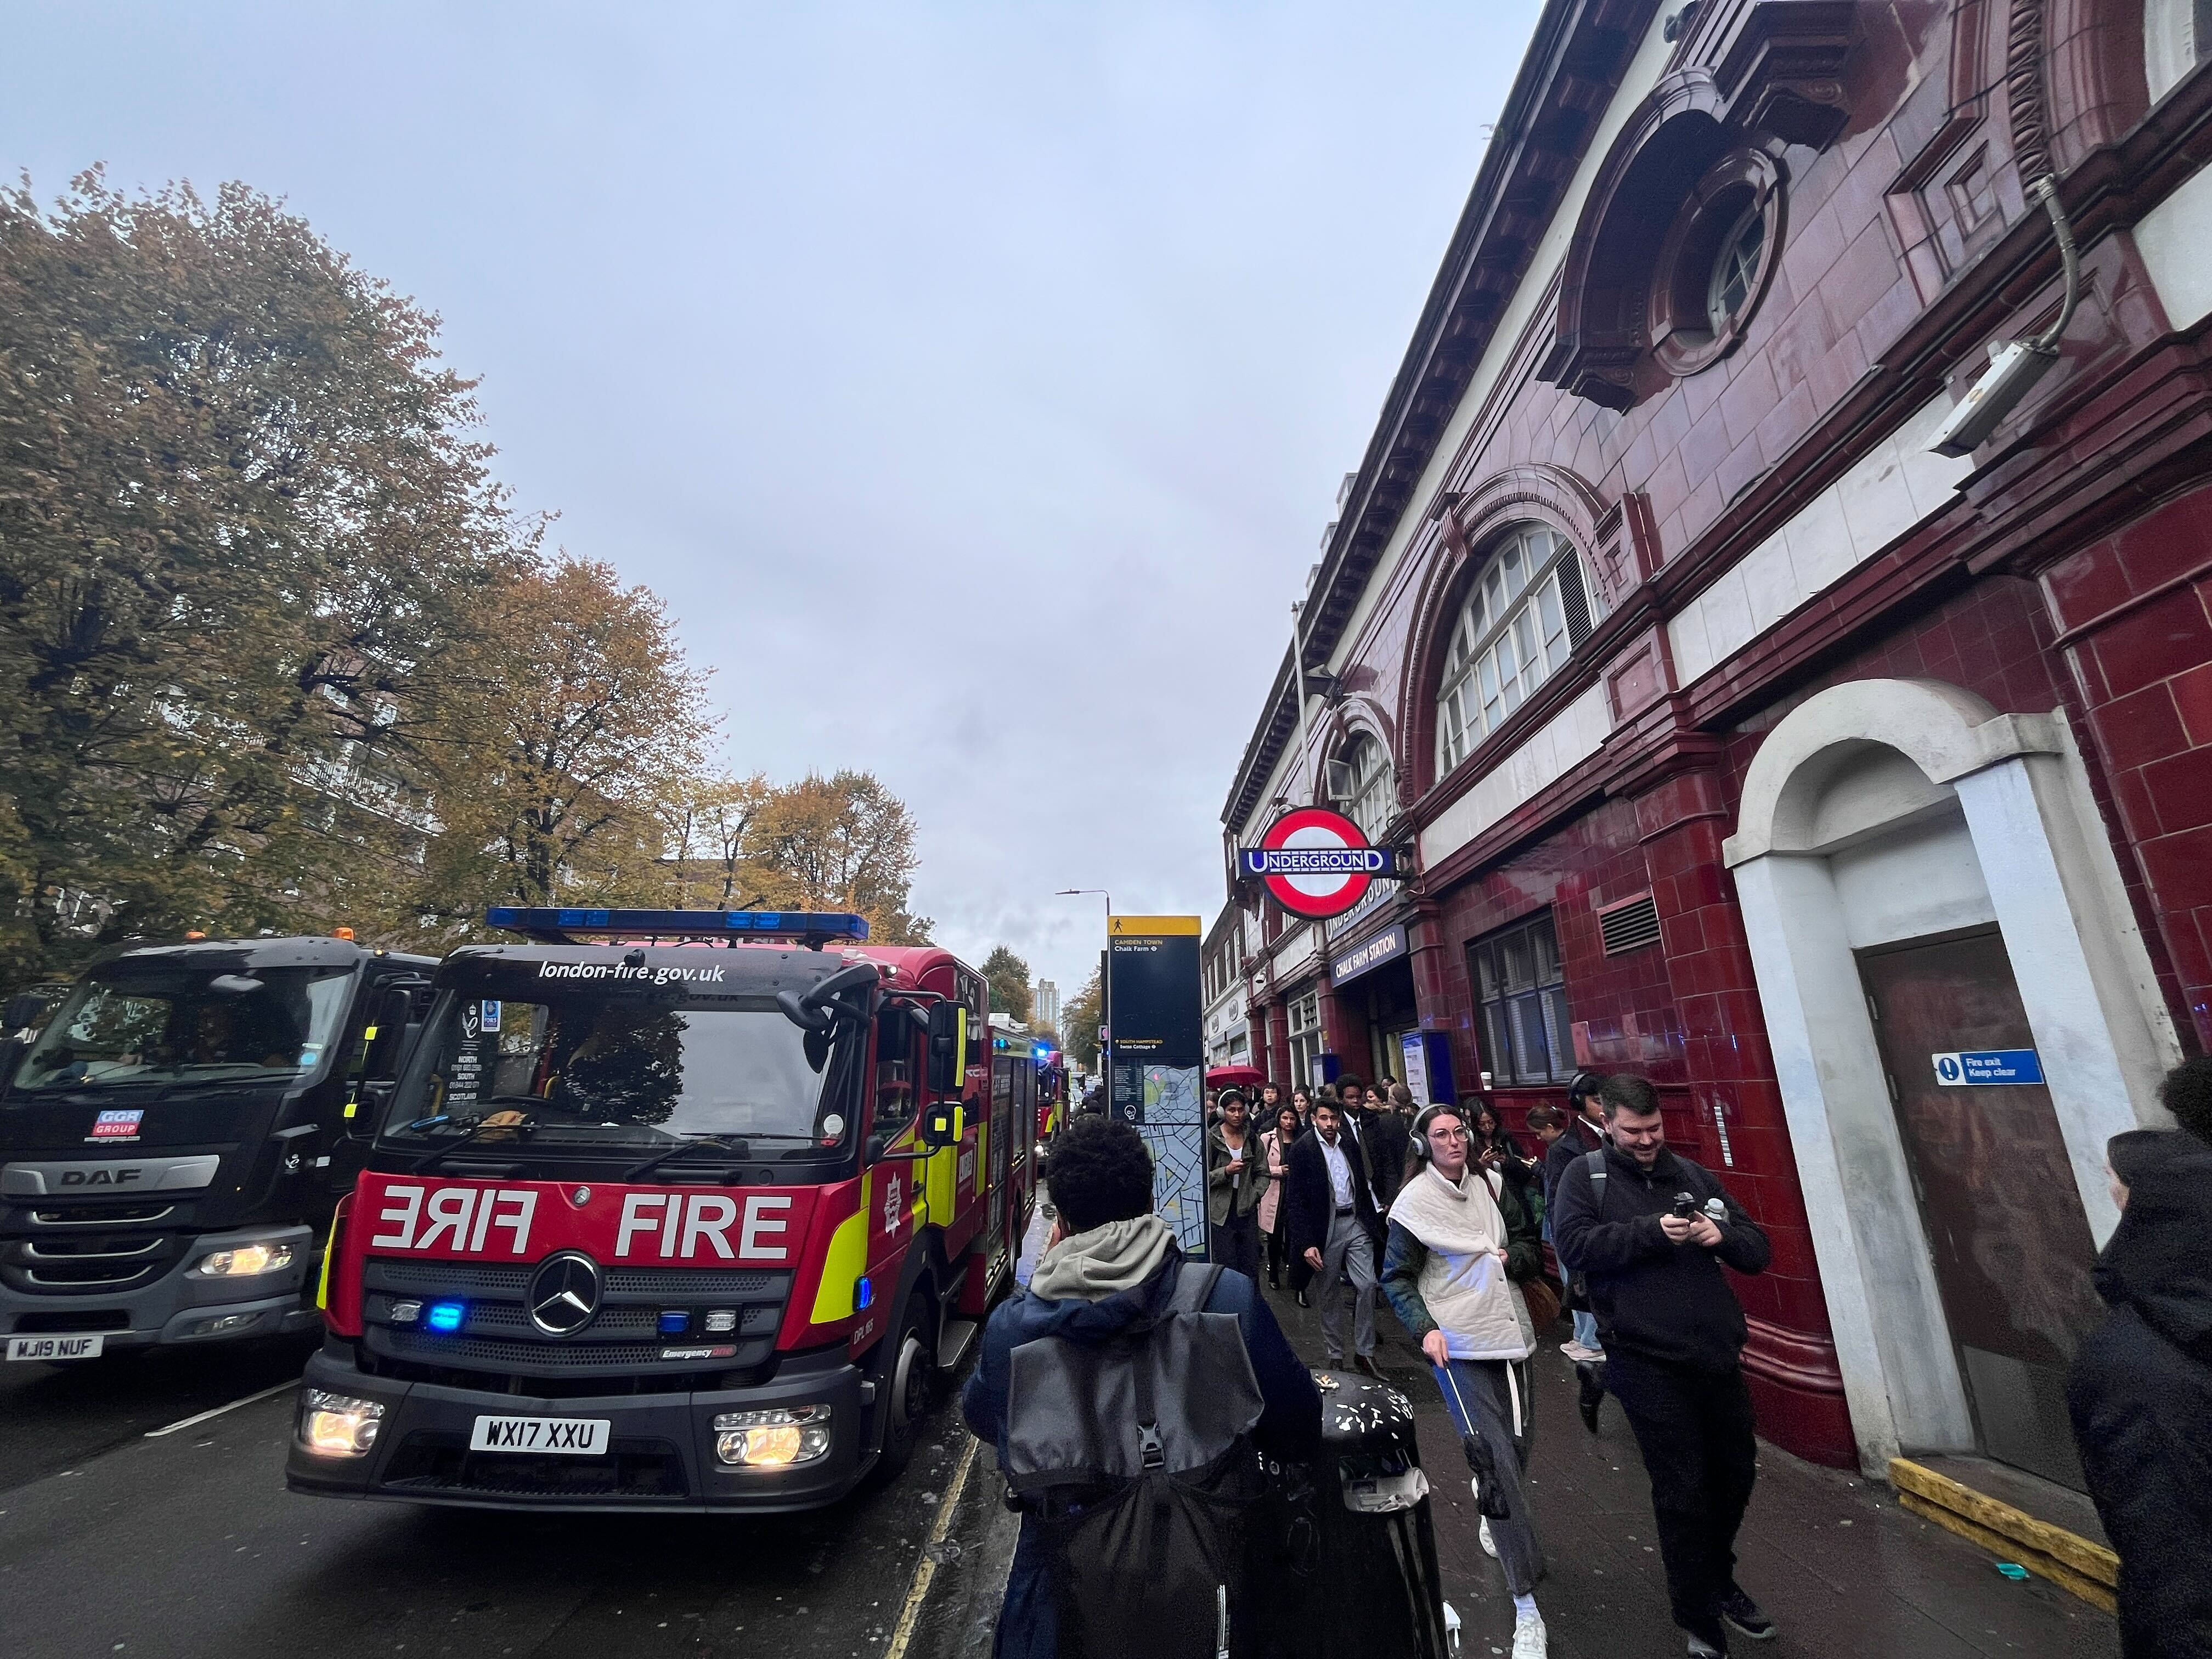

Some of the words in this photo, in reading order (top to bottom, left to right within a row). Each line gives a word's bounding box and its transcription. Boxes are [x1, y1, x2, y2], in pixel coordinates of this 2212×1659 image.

[1248, 850, 1384, 873] UNDERGROUND
[1335, 956, 1353, 978] CHALK
[1352, 947, 1369, 970] FARM
[1369, 932, 1396, 961] STATION
[539, 960, 725, 985] london-fire.gov.uk
[1966, 1058, 1983, 1066] Fire
[1984, 1057, 2001, 1066] exit
[1968, 1068, 1992, 1078] Keep
[1993, 1068, 2016, 1076] clear
[101, 1111, 139, 1122] GGR
[96, 1125, 136, 1133] GROUP
[61, 1169, 142, 1185] DAF
[615, 1193, 792, 1259] FIRE
[58, 1339, 93, 1356] NUF
[662, 1350, 712, 1359] Emergency
[486, 1421, 541, 1447] WX17
[545, 1423, 594, 1448] XXU
